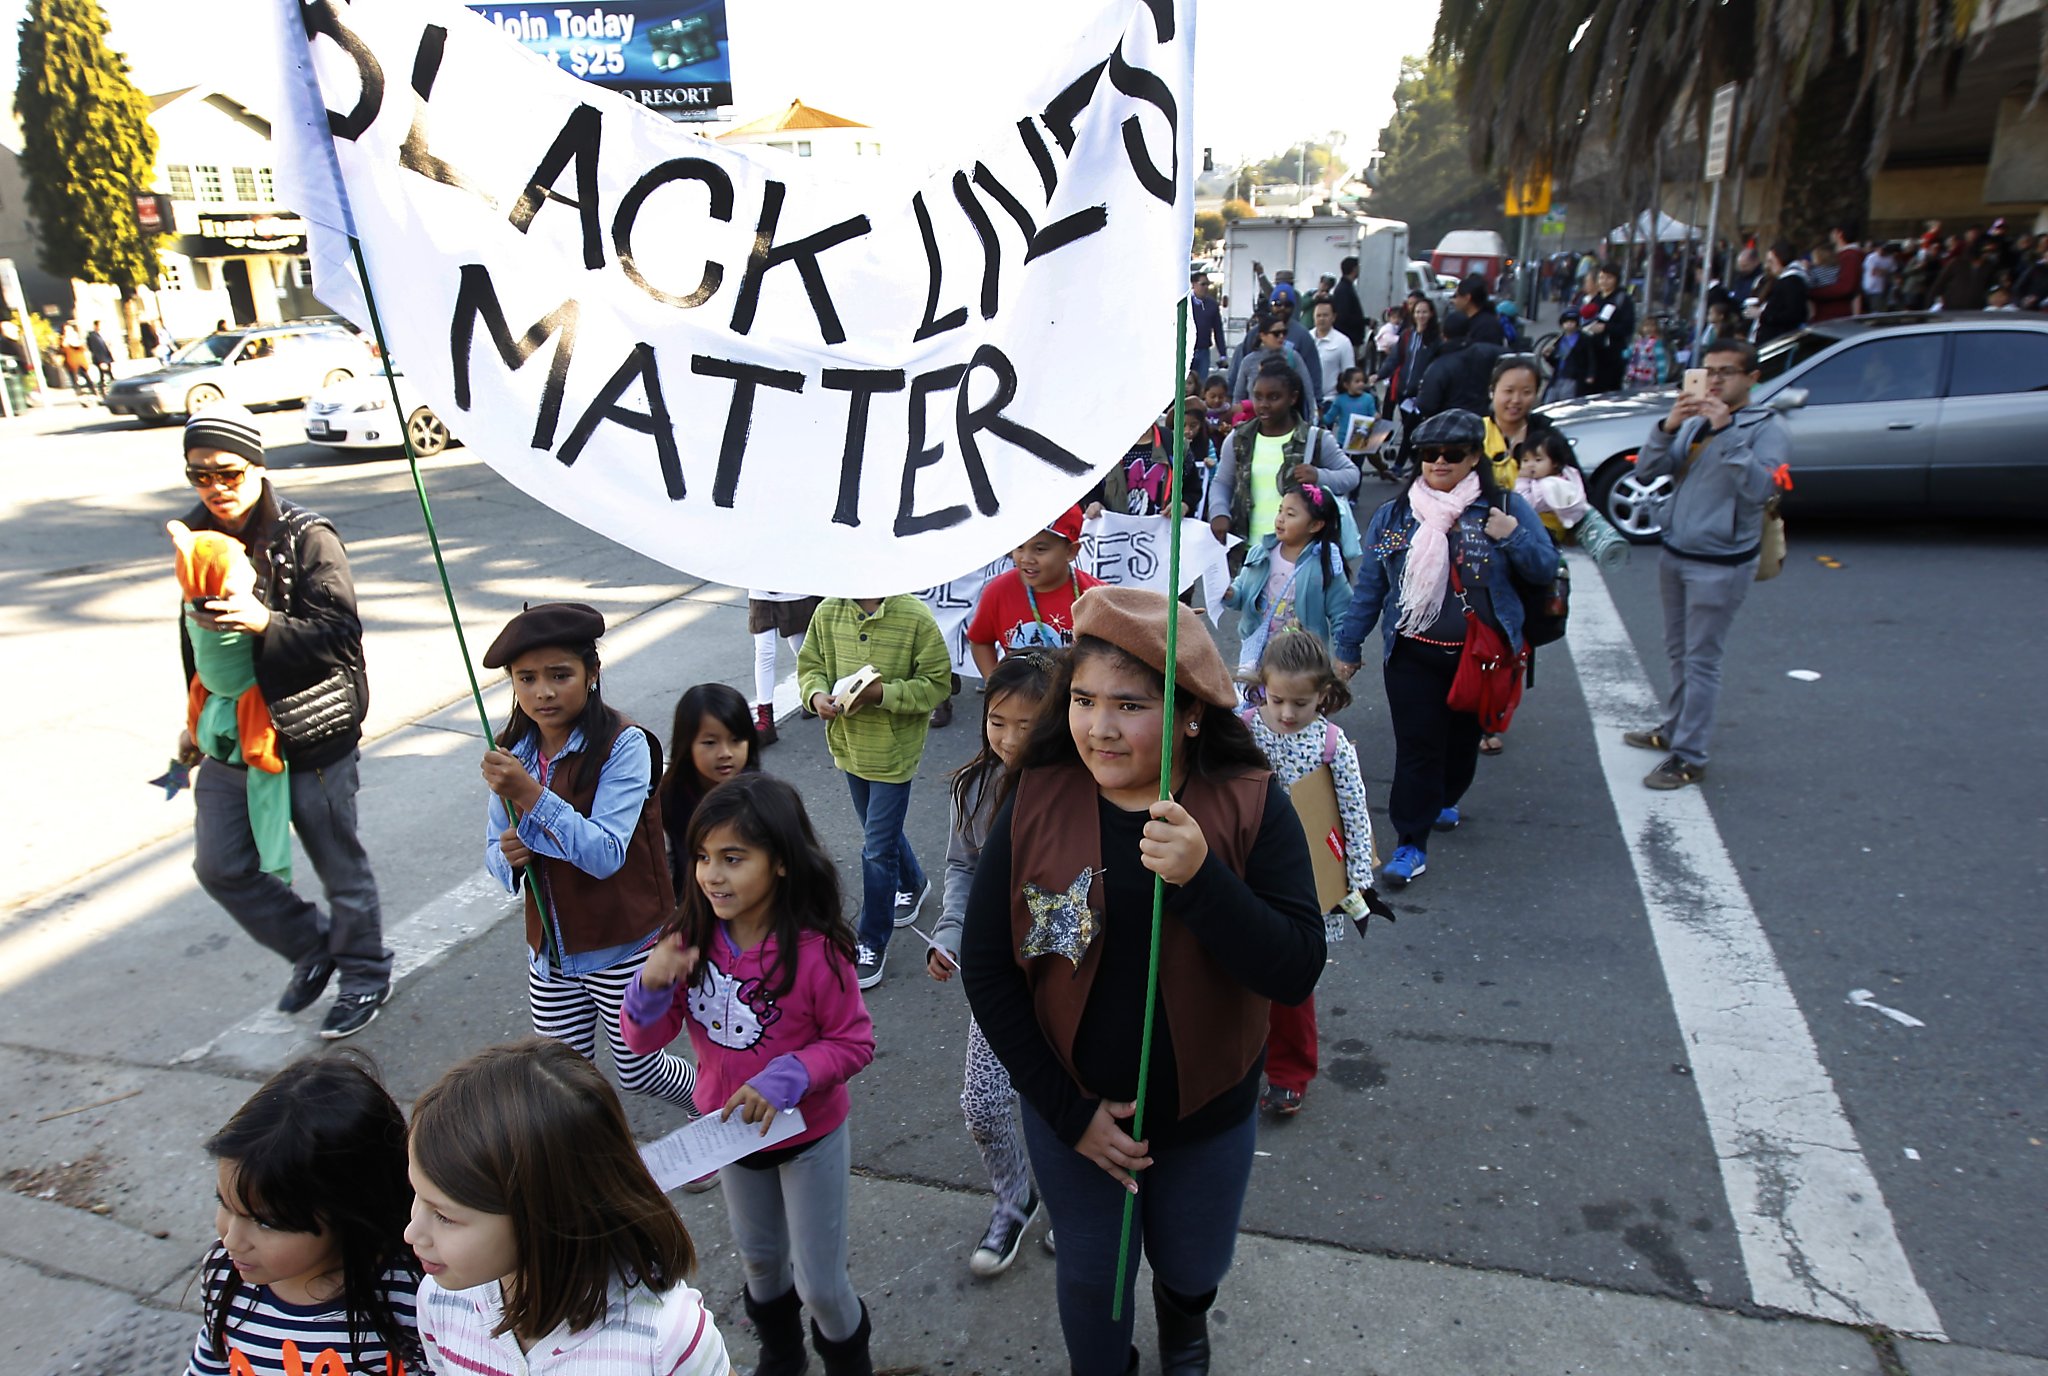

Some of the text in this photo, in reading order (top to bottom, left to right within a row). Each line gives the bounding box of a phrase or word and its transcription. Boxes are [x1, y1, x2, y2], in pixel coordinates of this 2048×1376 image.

[493, 8, 636, 44] Join Today
[569, 43, 626, 77] $25
[641, 87, 713, 105] RESORT
[911, 0, 1178, 343] LIVES
[451, 263, 1096, 539] MATTER
